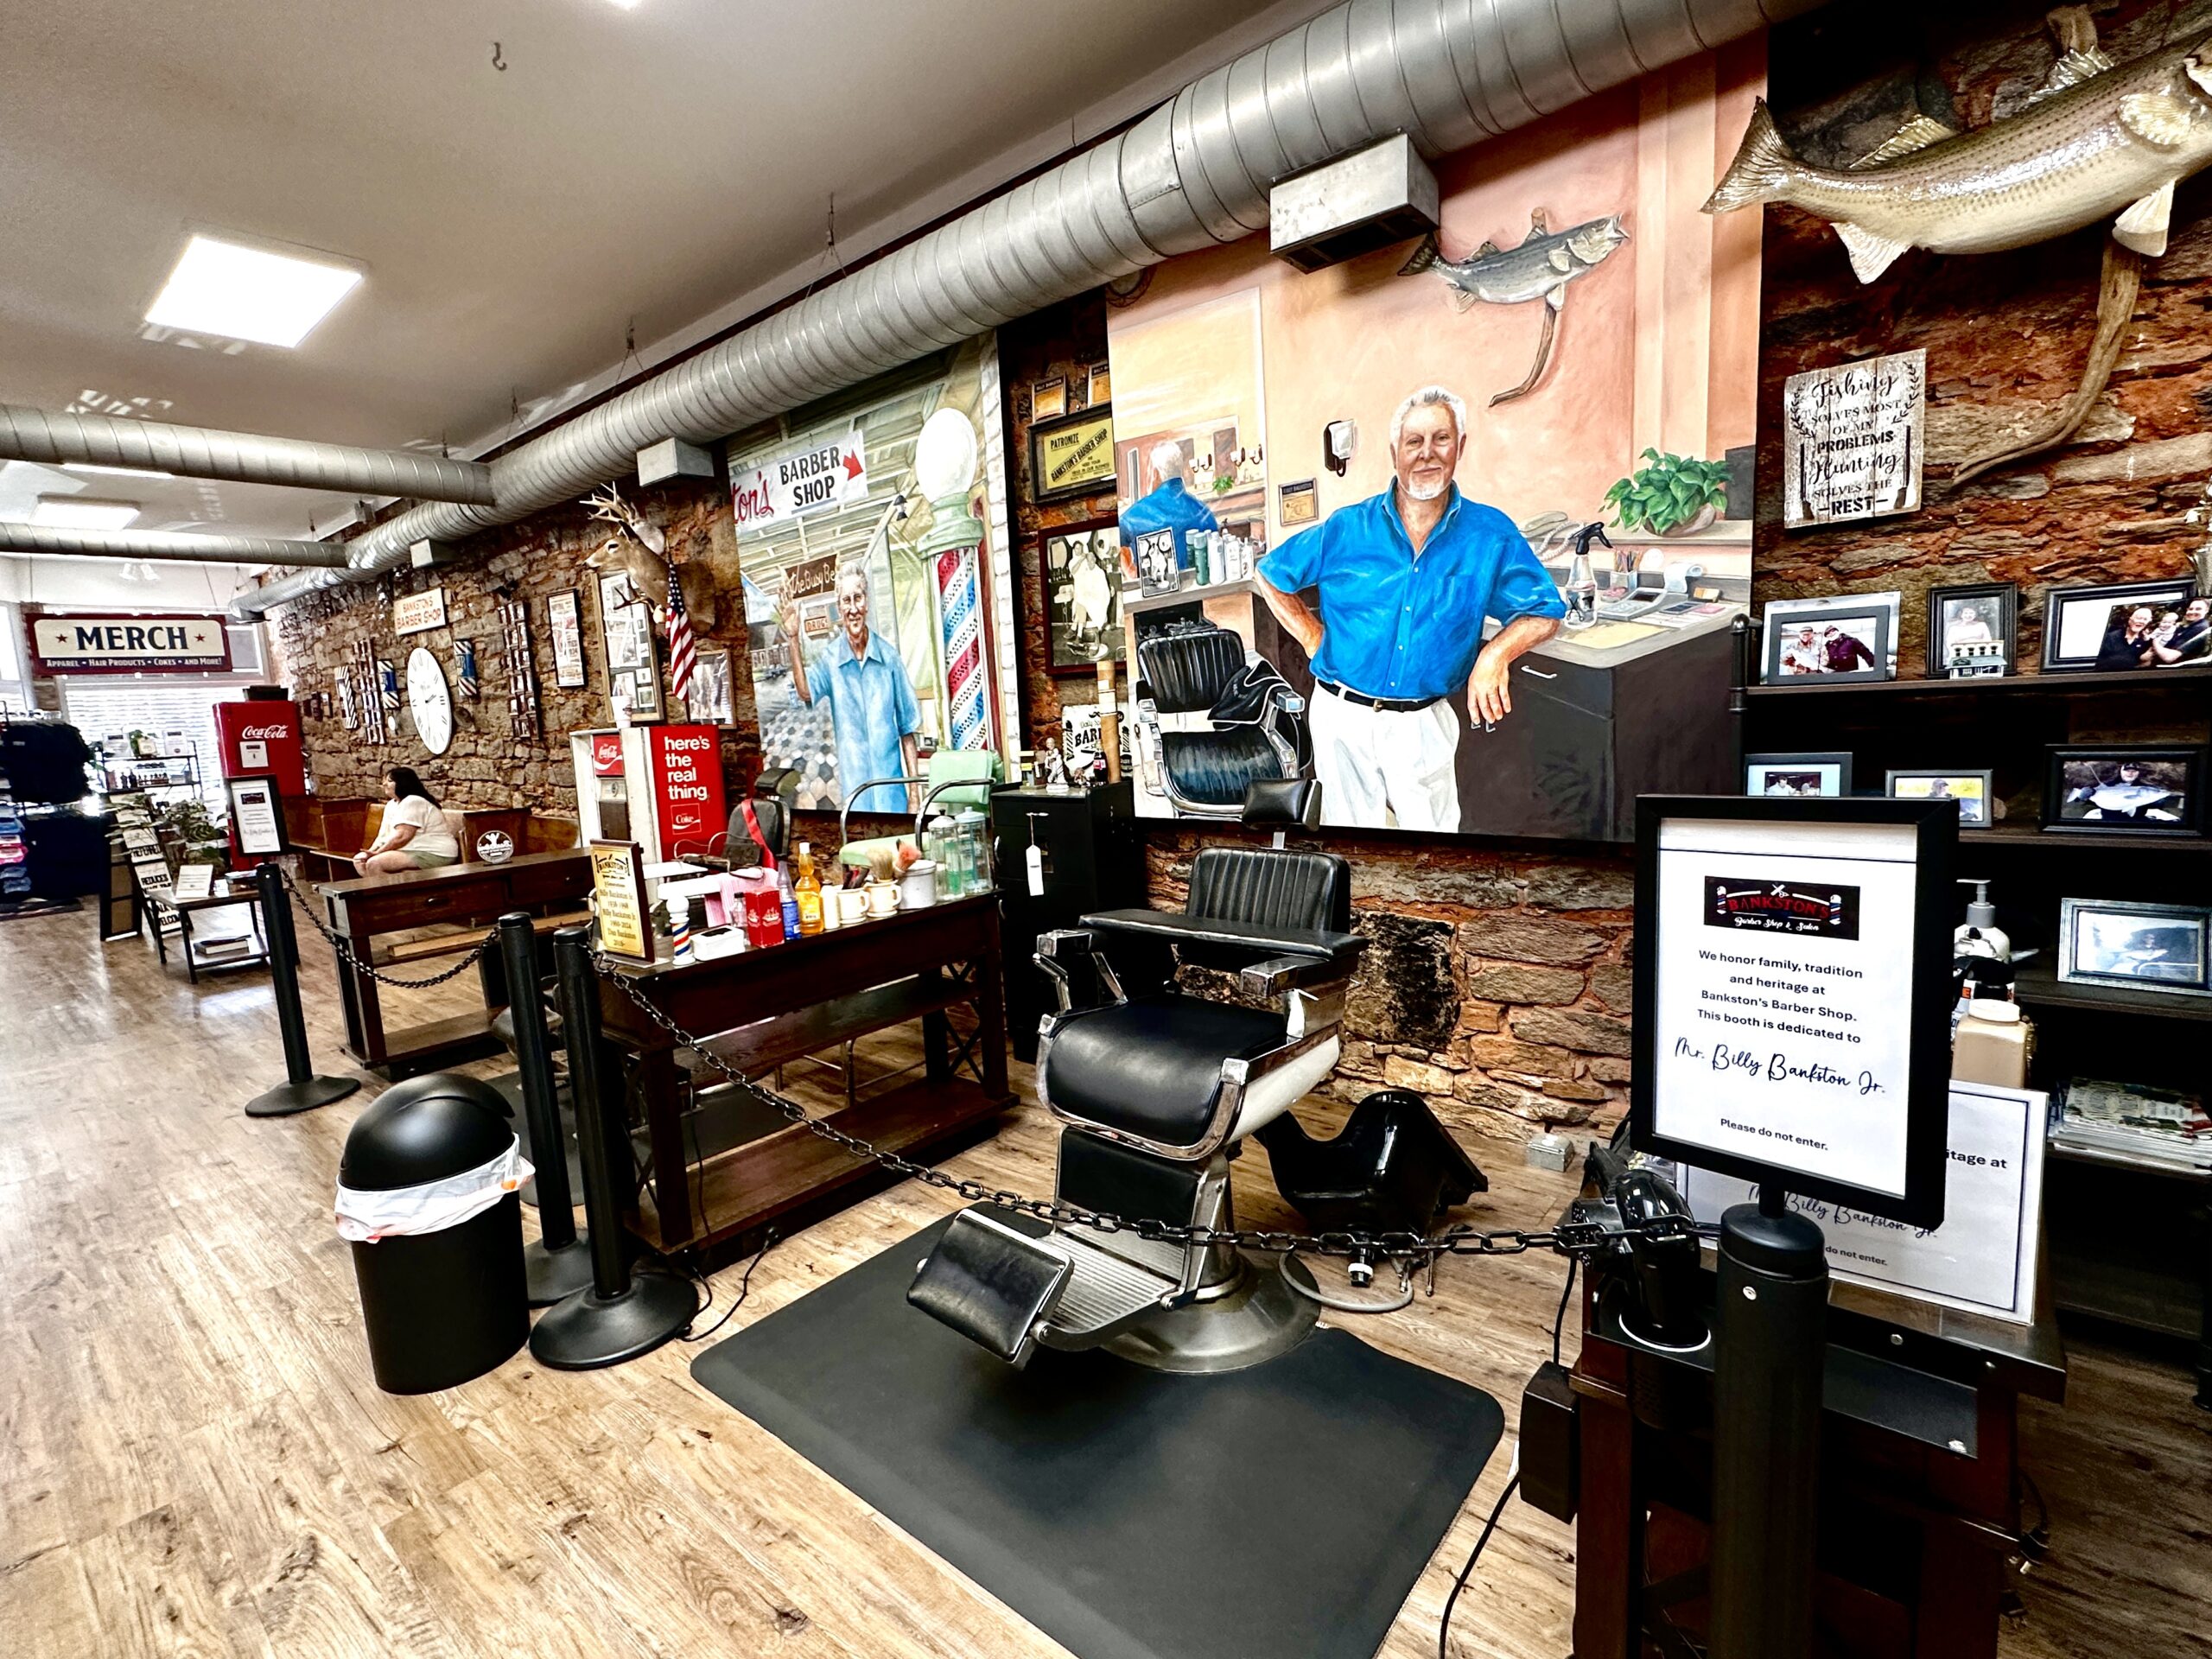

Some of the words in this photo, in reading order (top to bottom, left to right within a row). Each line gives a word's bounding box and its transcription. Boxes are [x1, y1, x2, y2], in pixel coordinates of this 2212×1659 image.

[1812, 372, 1899, 408] Fishing
[1812, 406, 1862, 423] SOLVES
[1864, 399, 1902, 414] MOST
[1833, 425, 1848, 435] OF
[1853, 420, 1873, 432] MY
[1051, 433, 1078, 449] PATRONIZE
[1077, 440, 1096, 460] BARBER
[1095, 429, 1108, 444] SHOP
[1817, 430, 1895, 454] PROBLEMS
[779, 446, 840, 485] BARBER
[1808, 452, 1901, 485] Hunting
[793, 475, 836, 506] SHOP
[1815, 484, 1863, 499] SOLVES
[1866, 480, 1893, 493] THE
[1832, 496, 1873, 515] REST
[74, 626, 189, 651] MERCH
[88, 658, 107, 667] HAIR
[242, 725, 289, 739] Coca-Cola
[664, 735, 710, 751] here's
[664, 753, 692, 768] the
[667, 767, 697, 783] real
[667, 785, 708, 801] thing
[1728, 897, 1830, 919] BANKSTON'S
[1734, 916, 1762, 927] Barber
[1764, 918, 1783, 929] Shop
[1796, 922, 1820, 931] Salon
[1699, 950, 1717, 961] We
[1719, 953, 1756, 965] honor
[1758, 957, 1802, 973] family,
[1805, 963, 1863, 979] tradition
[1730, 975, 1752, 985] and
[1757, 977, 1808, 994] heritage
[1812, 985, 1826, 995] at
[1701, 989, 1768, 1007] Bankston's
[1771, 1000, 1815, 1014] Barber
[1818, 1007, 1857, 1022] Shop.
[1698, 1009, 1720, 1021] This
[1724, 1013, 1760, 1027] booth
[1763, 1019, 1774, 1029] is
[1777, 1021, 1843, 1040] dedicated
[1847, 1033, 1861, 1043] to
[1675, 1036, 1705, 1059] Mr.
[1712, 1044, 1763, 1076] Billy
[1768, 1053, 1851, 1086] Bankston
[1859, 1071, 1885, 1095] Jr.
[1720, 1118, 1756, 1134] Please
[1758, 1127, 1772, 1137] do
[1775, 1132, 1793, 1142] not
[1796, 1136, 1828, 1151] enter.
[1946, 1149, 1986, 1166] itage
[1991, 1158, 2007, 1169] at
[1783, 1192, 1829, 1219] Billy
[1826, 1245, 1838, 1255] do
[1840, 1249, 1857, 1259] not
[1859, 1253, 1887, 1266] enter.
